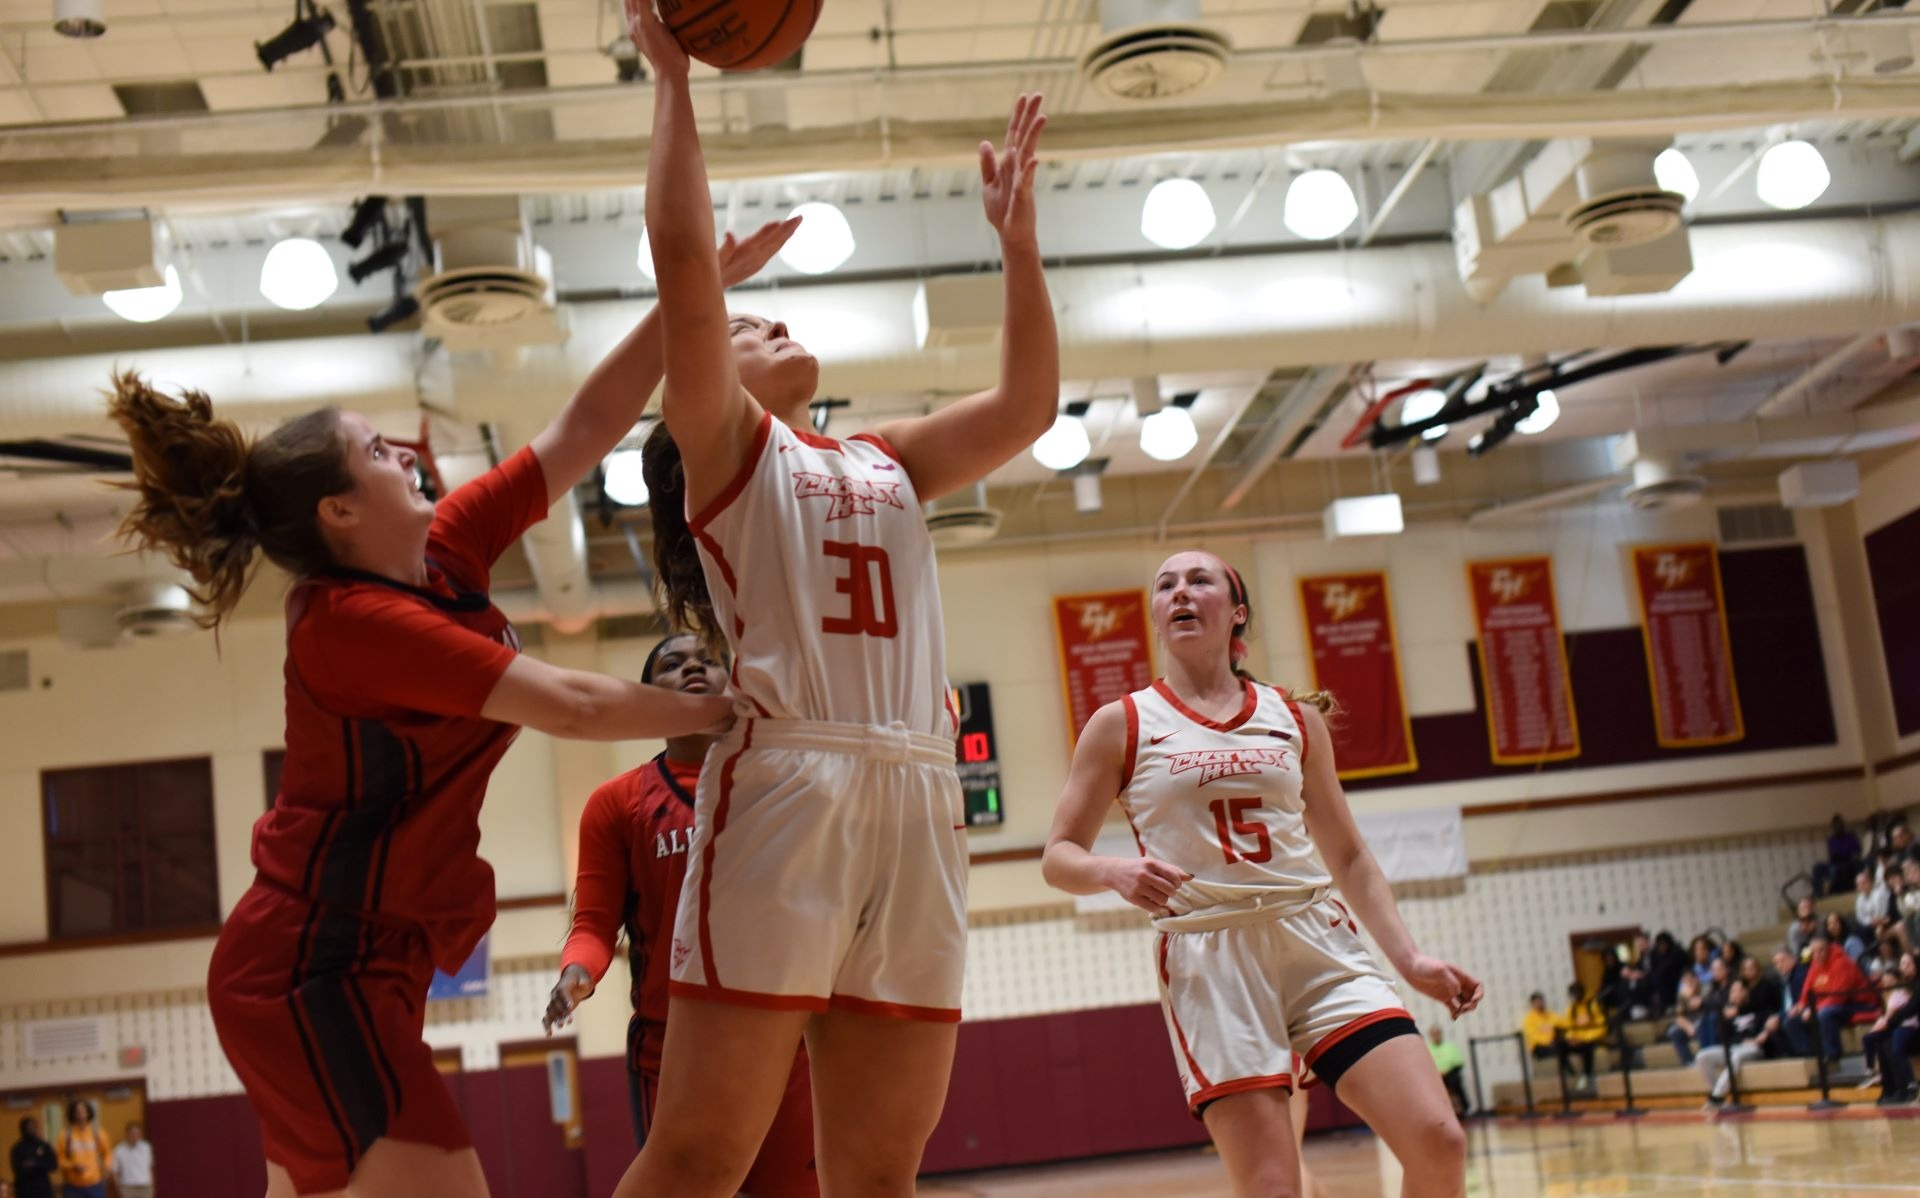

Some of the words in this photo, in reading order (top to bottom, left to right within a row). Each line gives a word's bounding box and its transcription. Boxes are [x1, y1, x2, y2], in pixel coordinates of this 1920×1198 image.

[821, 539, 898, 640] 30
[963, 732, 989, 763] 10
[1208, 797, 1272, 865] 15
